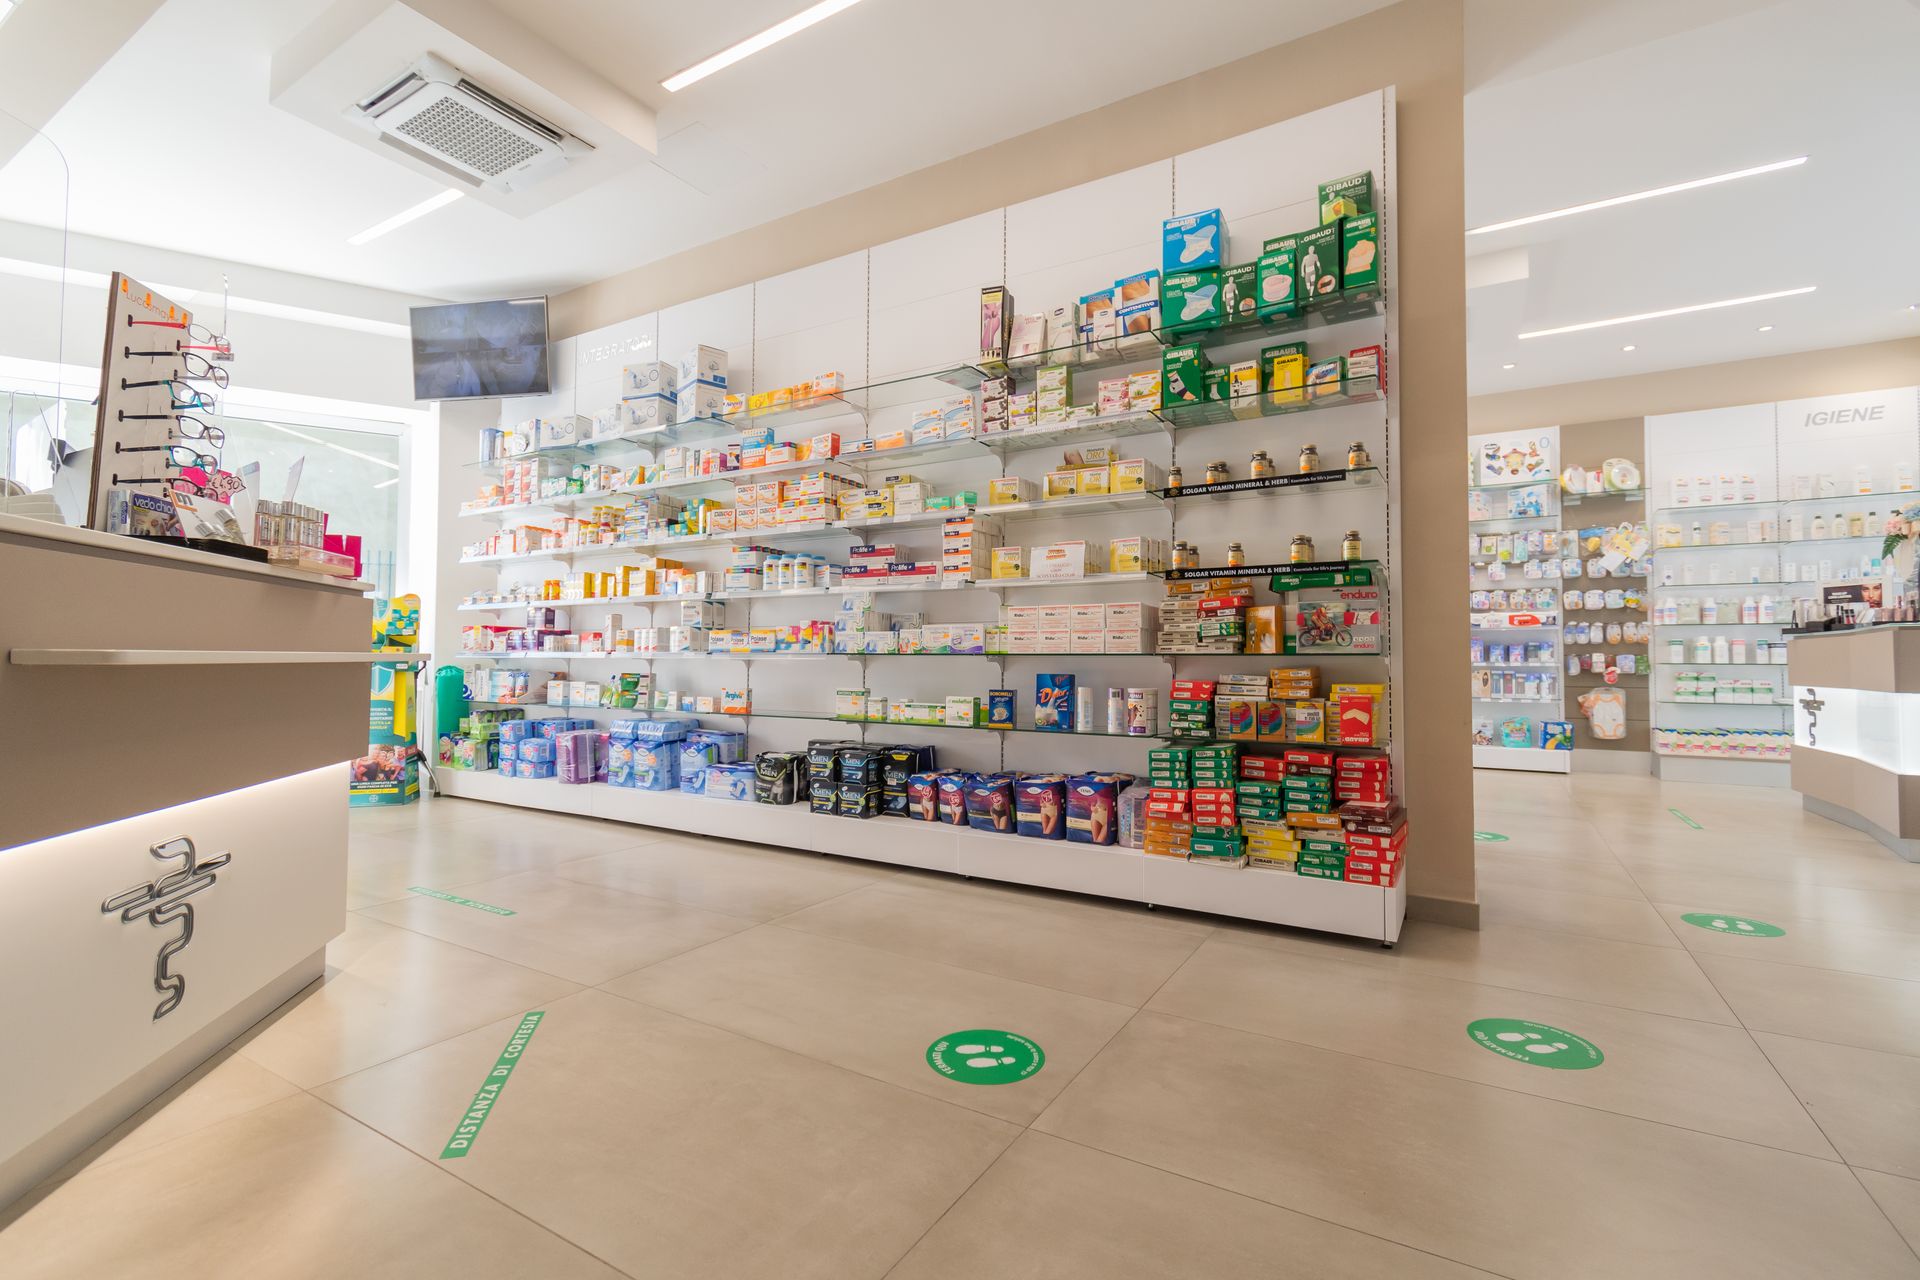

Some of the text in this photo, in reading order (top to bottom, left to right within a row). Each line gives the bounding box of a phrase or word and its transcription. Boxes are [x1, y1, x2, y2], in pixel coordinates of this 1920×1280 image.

[1326, 178, 1362, 193] GIBAUD
[1304, 229, 1332, 242] GIBAUD
[1225, 266, 1252, 277] GIBAUD
[1804, 405, 1885, 427] IGIENE
[1182, 486, 1207, 495] SOLGAR
[1208, 483, 1234, 492] VITAMIN
[1235, 481, 1263, 490] MINERAL
[1264, 479, 1270, 487] &
[1271, 477, 1288, 486] HERB
[134, 497, 155, 511] vedo
[1184, 570, 1209, 579] SOLGAR
[1210, 568, 1236, 577] VITAMIN
[1237, 567, 1266, 576] MINERAL
[1273, 566, 1291, 574] HERB
[1340, 589, 1378, 600] enduro
[811, 755, 829, 763] MEN
[760, 769, 778, 778] MEN
[885, 772, 906, 780] MEN
[932, 1052, 955, 1074] FERMATI
[449, 1015, 540, 1148] DISTANZA DI CORTESIA
